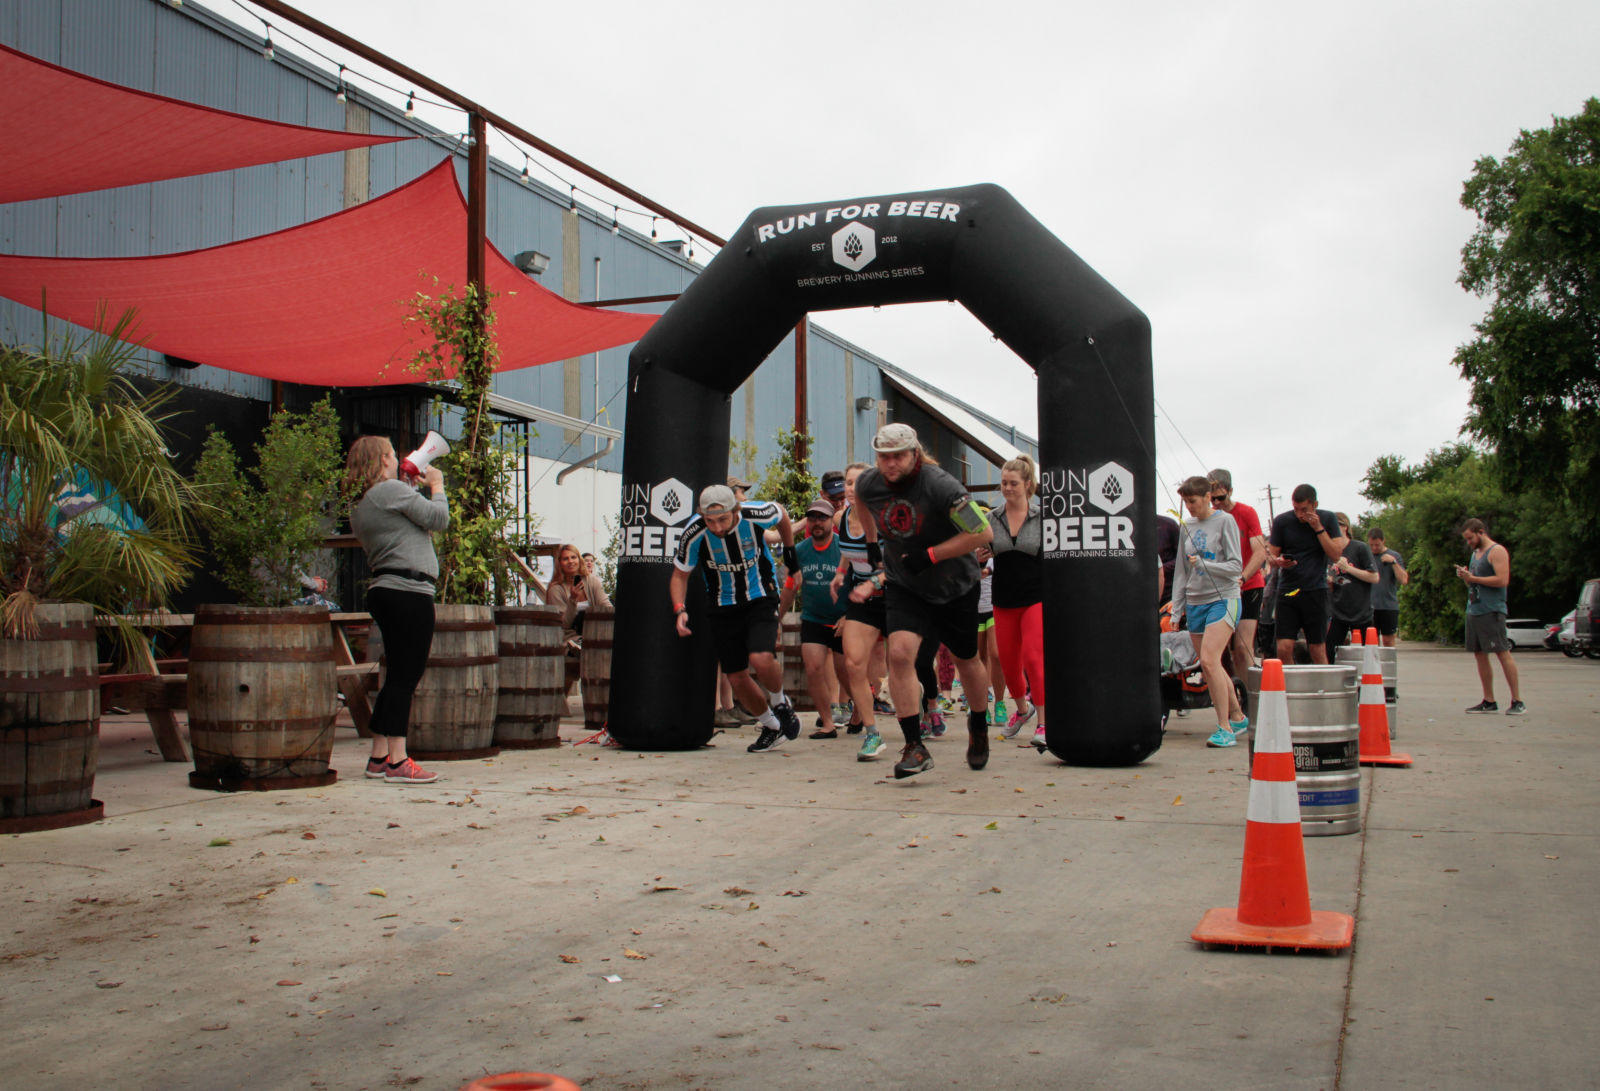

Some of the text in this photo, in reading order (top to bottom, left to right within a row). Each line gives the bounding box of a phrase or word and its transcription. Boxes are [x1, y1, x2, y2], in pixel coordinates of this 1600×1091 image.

[758, 201, 961, 242] RUN FOR BEER
[811, 236, 898, 251] EST 2012
[797, 266, 925, 287] BREWERY RUNNING SERIES
[1041, 468, 1087, 494] RUN
[621, 482, 650, 504] UN
[620, 505, 648, 525] OR
[1042, 493, 1085, 517] FOR
[1042, 516, 1136, 552] BEER
[1069, 550, 1107, 558] RUNNING
[1108, 549, 1135, 557] SERIES
[1293, 746, 1310, 757] ops
[1295, 756, 1319, 769] grain
